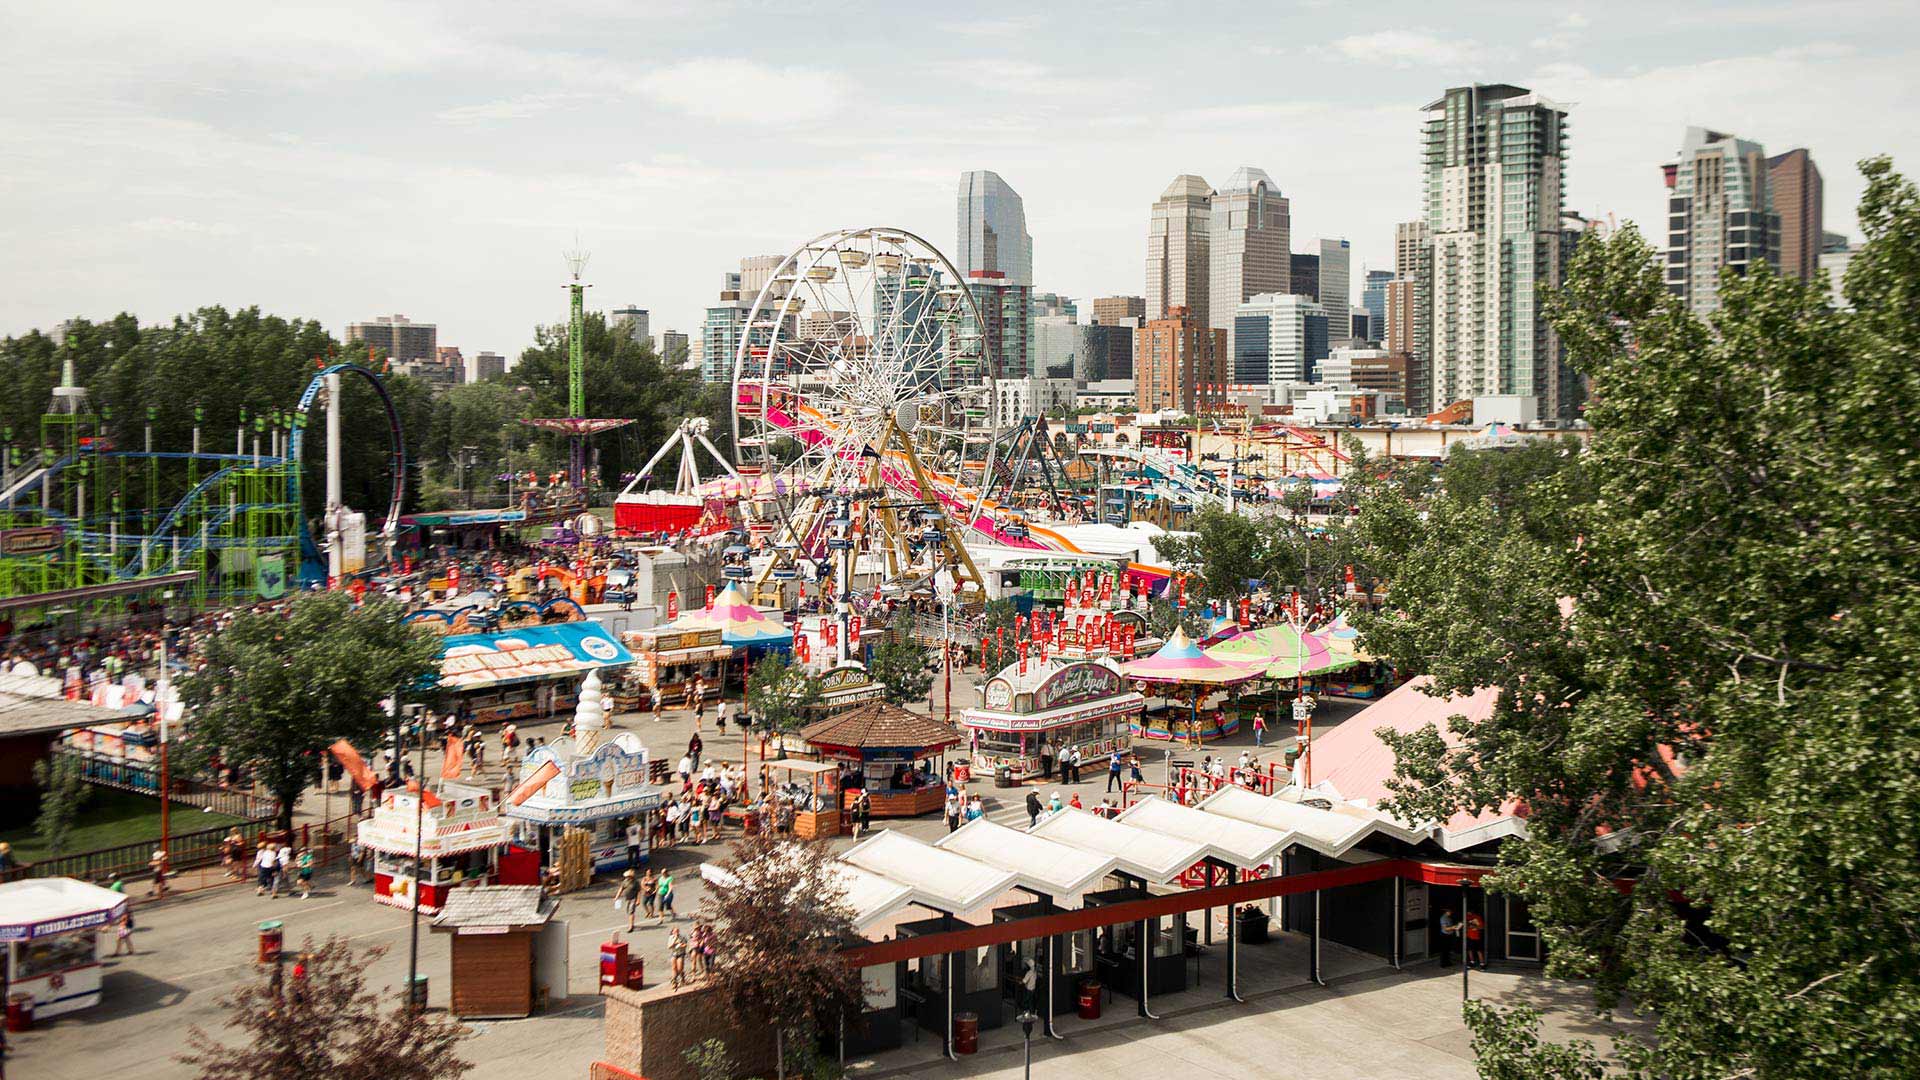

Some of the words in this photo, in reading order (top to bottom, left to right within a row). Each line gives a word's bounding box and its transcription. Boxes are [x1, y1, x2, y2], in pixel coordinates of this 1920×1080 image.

[821, 675, 841, 688] CORN
[846, 673, 864, 683] DOGS
[1048, 670, 1082, 702] Sweet
[1083, 670, 1109, 694] Spot
[827, 694, 856, 706] JUMBO
[1295, 708, 1305, 718] 30
